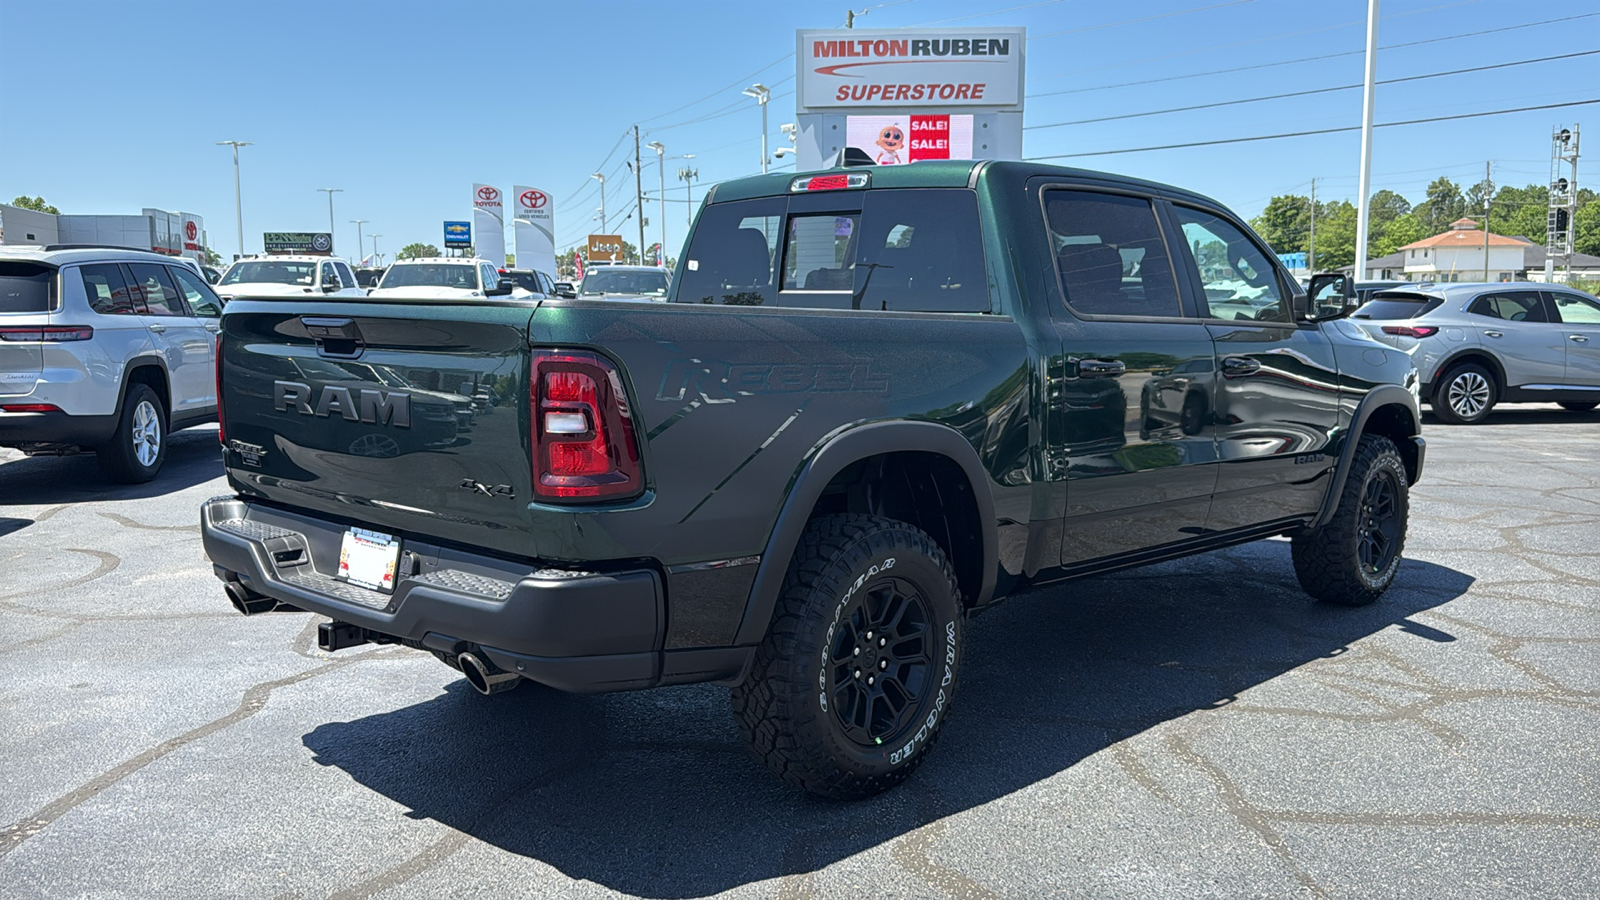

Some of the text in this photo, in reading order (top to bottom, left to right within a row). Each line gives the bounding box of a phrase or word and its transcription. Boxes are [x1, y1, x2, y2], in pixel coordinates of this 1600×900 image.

[813, 39, 1010, 58] MILTON RUBEN
[836, 83, 986, 102] SUPERSTORE
[911, 120, 948, 131] SALE!
[911, 139, 948, 150] SALE!
[591, 241, 621, 254] Jeep
[274, 380, 412, 428] RAM
[1293, 453, 1326, 465] RAM
[889, 621, 956, 765] WRANGLER
